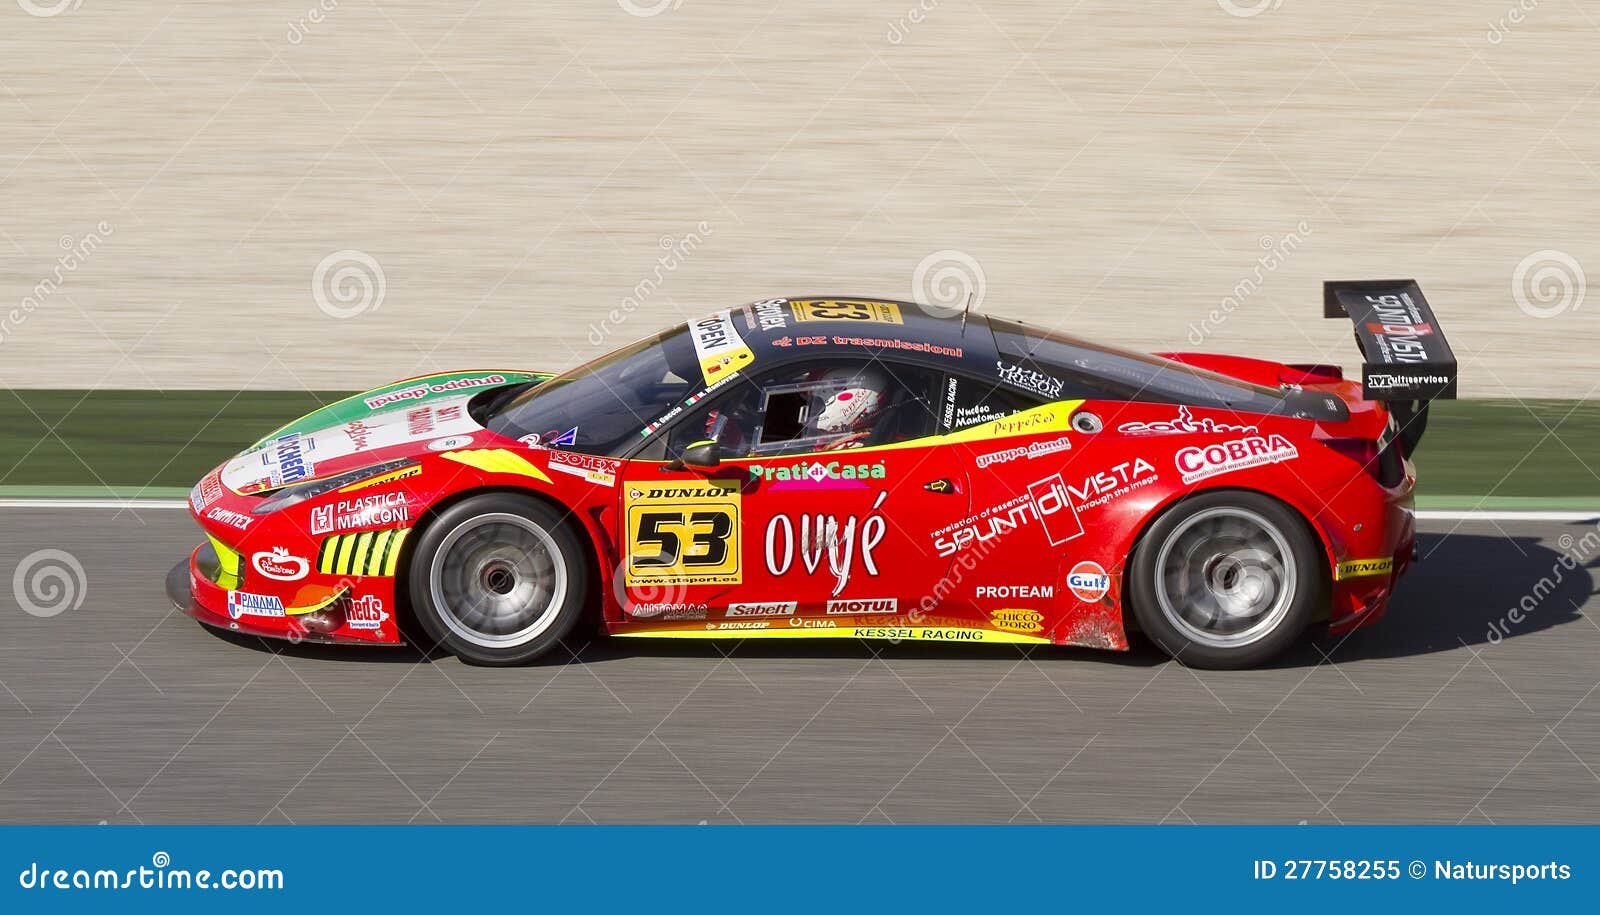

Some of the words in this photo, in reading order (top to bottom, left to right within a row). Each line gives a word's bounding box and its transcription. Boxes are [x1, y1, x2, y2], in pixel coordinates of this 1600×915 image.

[809, 301, 870, 320] 53
[697, 318, 728, 350] OPEN
[797, 336, 827, 346] DZ
[833, 336, 964, 358] trasmissioni
[432, 376, 505, 393] gruppo
[948, 377, 958, 402] RACING
[368, 387, 426, 409] dondi
[943, 401, 954, 429] KESSEL
[955, 411, 1006, 428] Mantomax
[957, 405, 990, 418] Nucleo
[549, 450, 617, 474] ISOTEX
[977, 446, 1027, 467] gruppo
[1027, 437, 1070, 453] dondi
[1178, 436, 1293, 473] COBRA
[749, 462, 807, 481] Prati
[811, 465, 824, 477] di
[826, 461, 885, 480] Casa
[337, 491, 407, 514] PLASTICA
[646, 488, 737, 500] DUNLOP
[1076, 493, 1113, 514] through
[1113, 486, 1130, 499] the
[1130, 474, 1160, 491] image
[930, 514, 978, 538] revelation
[992, 494, 1030, 514] essence
[935, 502, 1040, 558] SPUNTI
[1037, 483, 1069, 516] di
[1068, 457, 1156, 501] VISTA
[337, 506, 409, 530] MARCONI
[632, 511, 733, 568] 53
[629, 576, 739, 585] www.gtsport.es
[1069, 575, 1108, 589] Gulf
[241, 593, 283, 611] PANAMA
[976, 586, 1054, 598] PROTEAM
[733, 602, 788, 616] Sabelt
[829, 601, 895, 613] MOTUL
[718, 622, 770, 630] DUNLOP
[803, 620, 837, 629] CIMA
[854, 628, 917, 638] KESSEL
[922, 630, 984, 640] RACING
